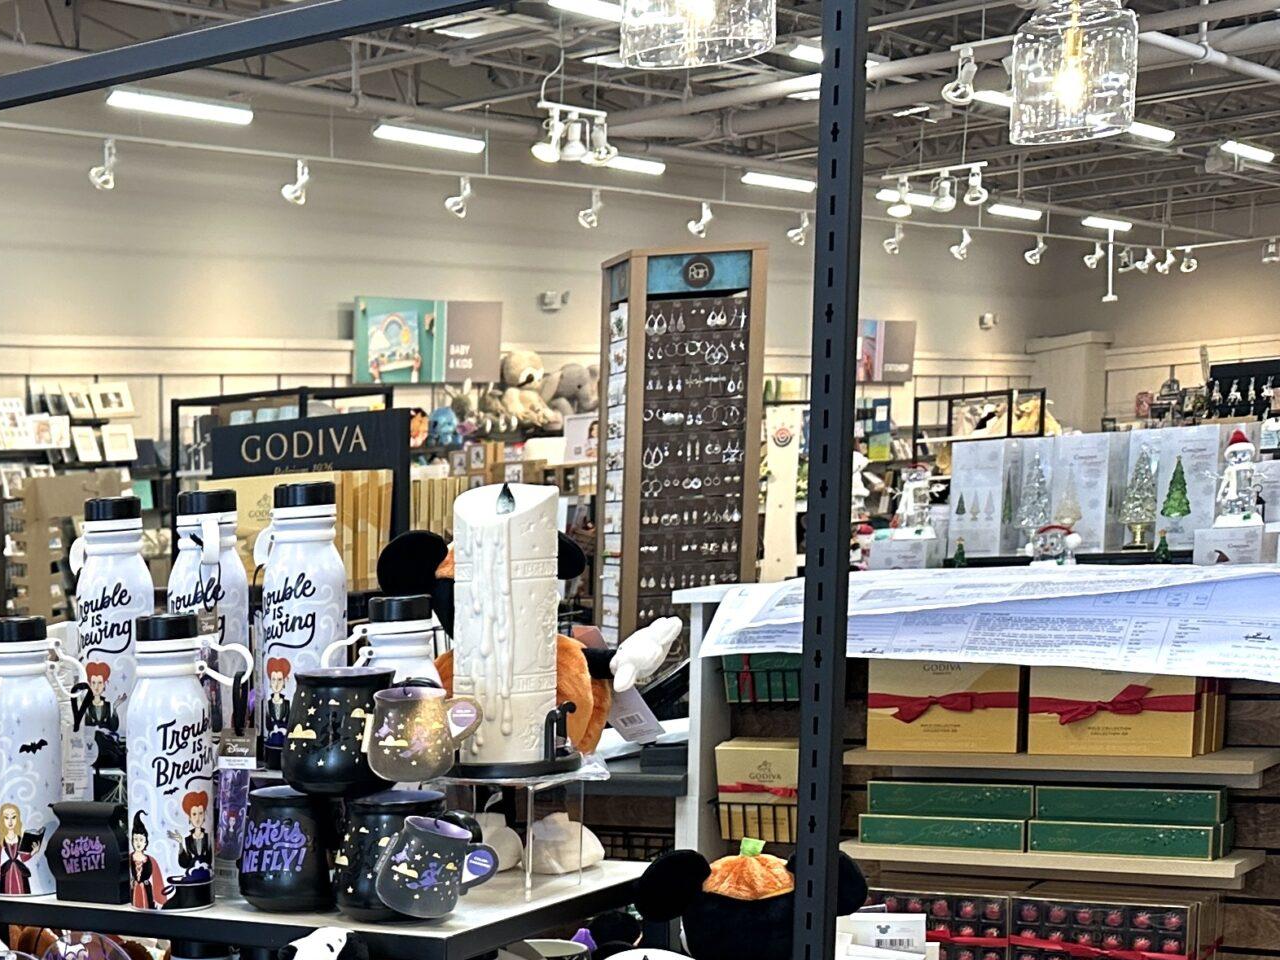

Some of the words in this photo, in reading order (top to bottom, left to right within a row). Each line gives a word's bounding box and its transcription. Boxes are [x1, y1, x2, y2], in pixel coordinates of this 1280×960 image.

[240, 424, 368, 464] GODIVA
[91, 614, 102, 627] IS
[272, 606, 283, 620] IS
[923, 663, 962, 673] GODIVA
[192, 738, 204, 755] IS
[748, 772, 782, 781] GODIVA
[62, 859, 83, 875] WE
[83, 853, 106, 872] FLY!
[261, 847, 307, 872] FLY!
